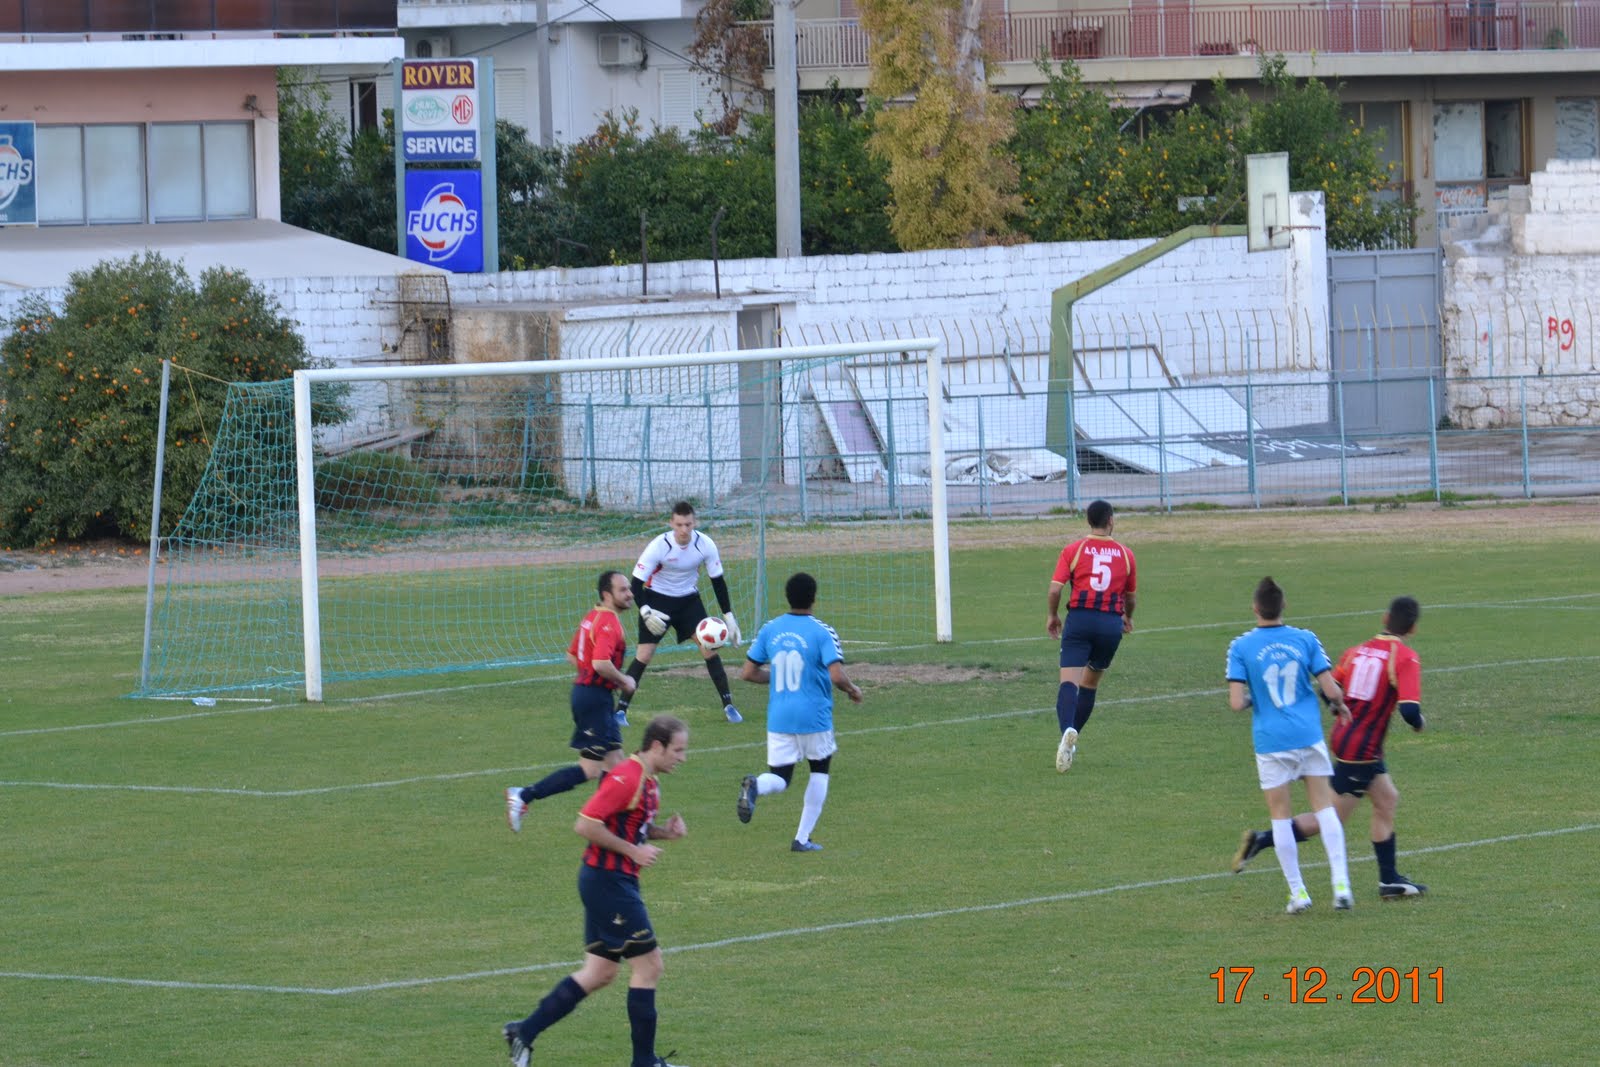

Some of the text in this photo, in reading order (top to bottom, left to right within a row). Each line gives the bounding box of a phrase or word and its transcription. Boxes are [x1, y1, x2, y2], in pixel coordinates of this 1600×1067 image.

[404, 65, 474, 86] ROVER
[454, 98, 471, 121] MG
[406, 136, 474, 154] SERVICE
[409, 212, 477, 232] FUCHS
[1089, 554, 1113, 592] 5
[771, 650, 804, 692] 10
[1262, 660, 1299, 709] 11
[1346, 655, 1384, 702] 10
